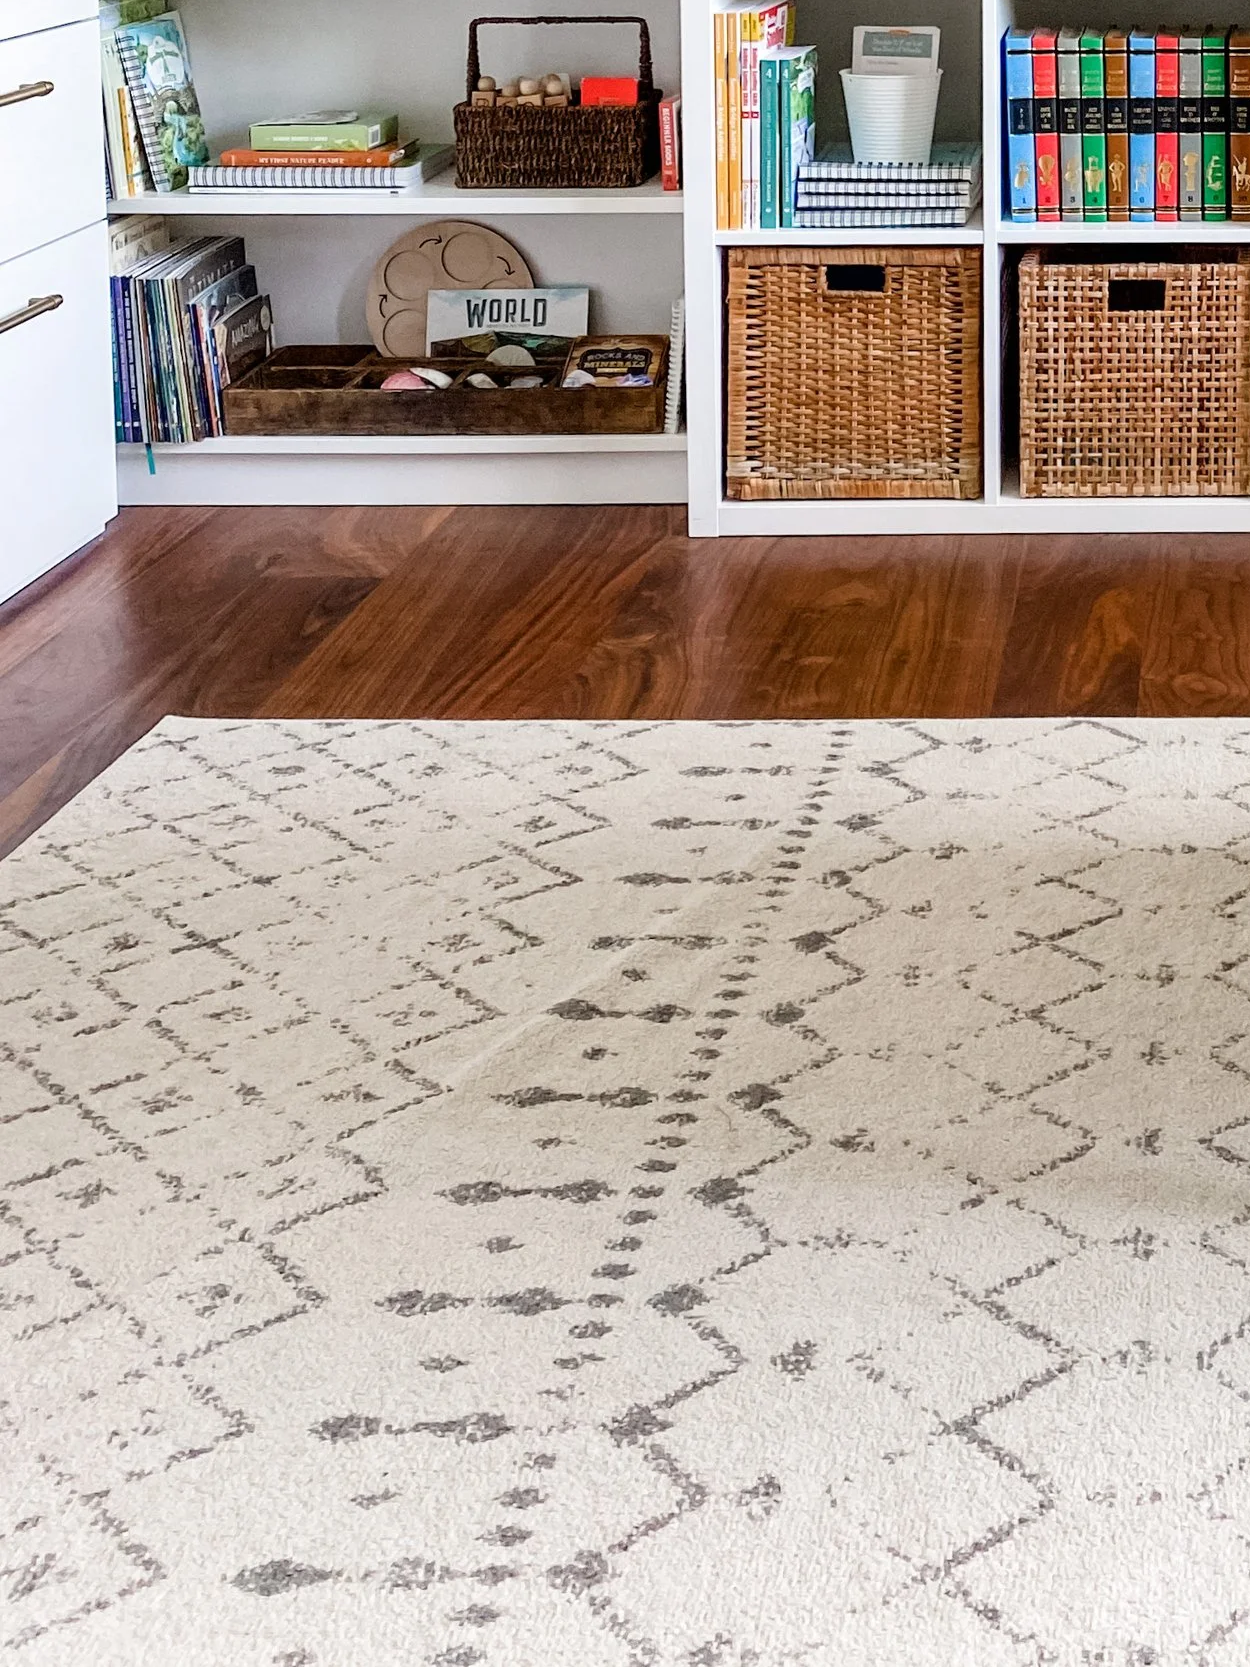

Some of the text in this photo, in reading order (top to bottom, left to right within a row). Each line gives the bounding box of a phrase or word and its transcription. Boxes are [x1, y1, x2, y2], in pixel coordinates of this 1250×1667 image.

[662, 107, 673, 145] BEGINNER
[466, 298, 548, 329] WORLD
[583, 361, 646, 371] MINERALS
[587, 351, 646, 362] ROCKS AND
